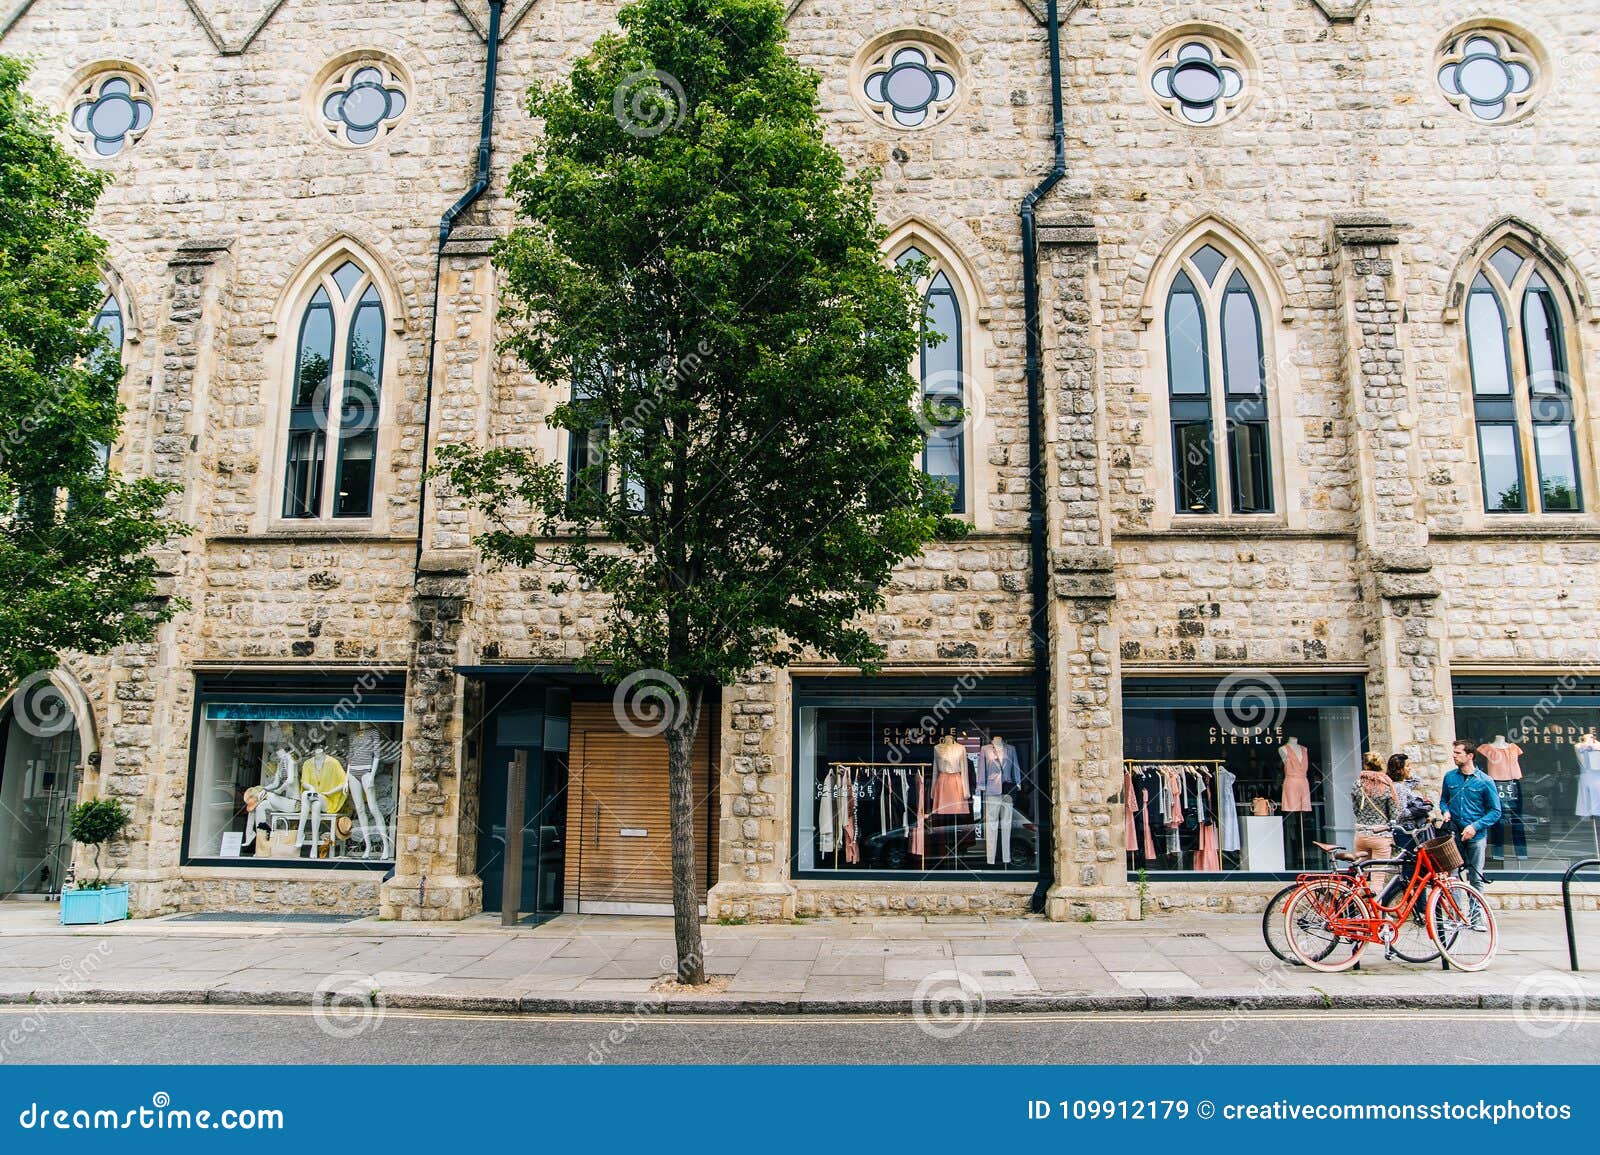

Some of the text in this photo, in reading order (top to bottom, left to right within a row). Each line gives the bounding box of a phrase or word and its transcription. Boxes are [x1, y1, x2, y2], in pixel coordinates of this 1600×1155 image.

[1209, 727, 1283, 735] CLAUDIE
[1523, 726, 1597, 735] CLAUDIE
[1209, 736, 1284, 745] PIERLOT
